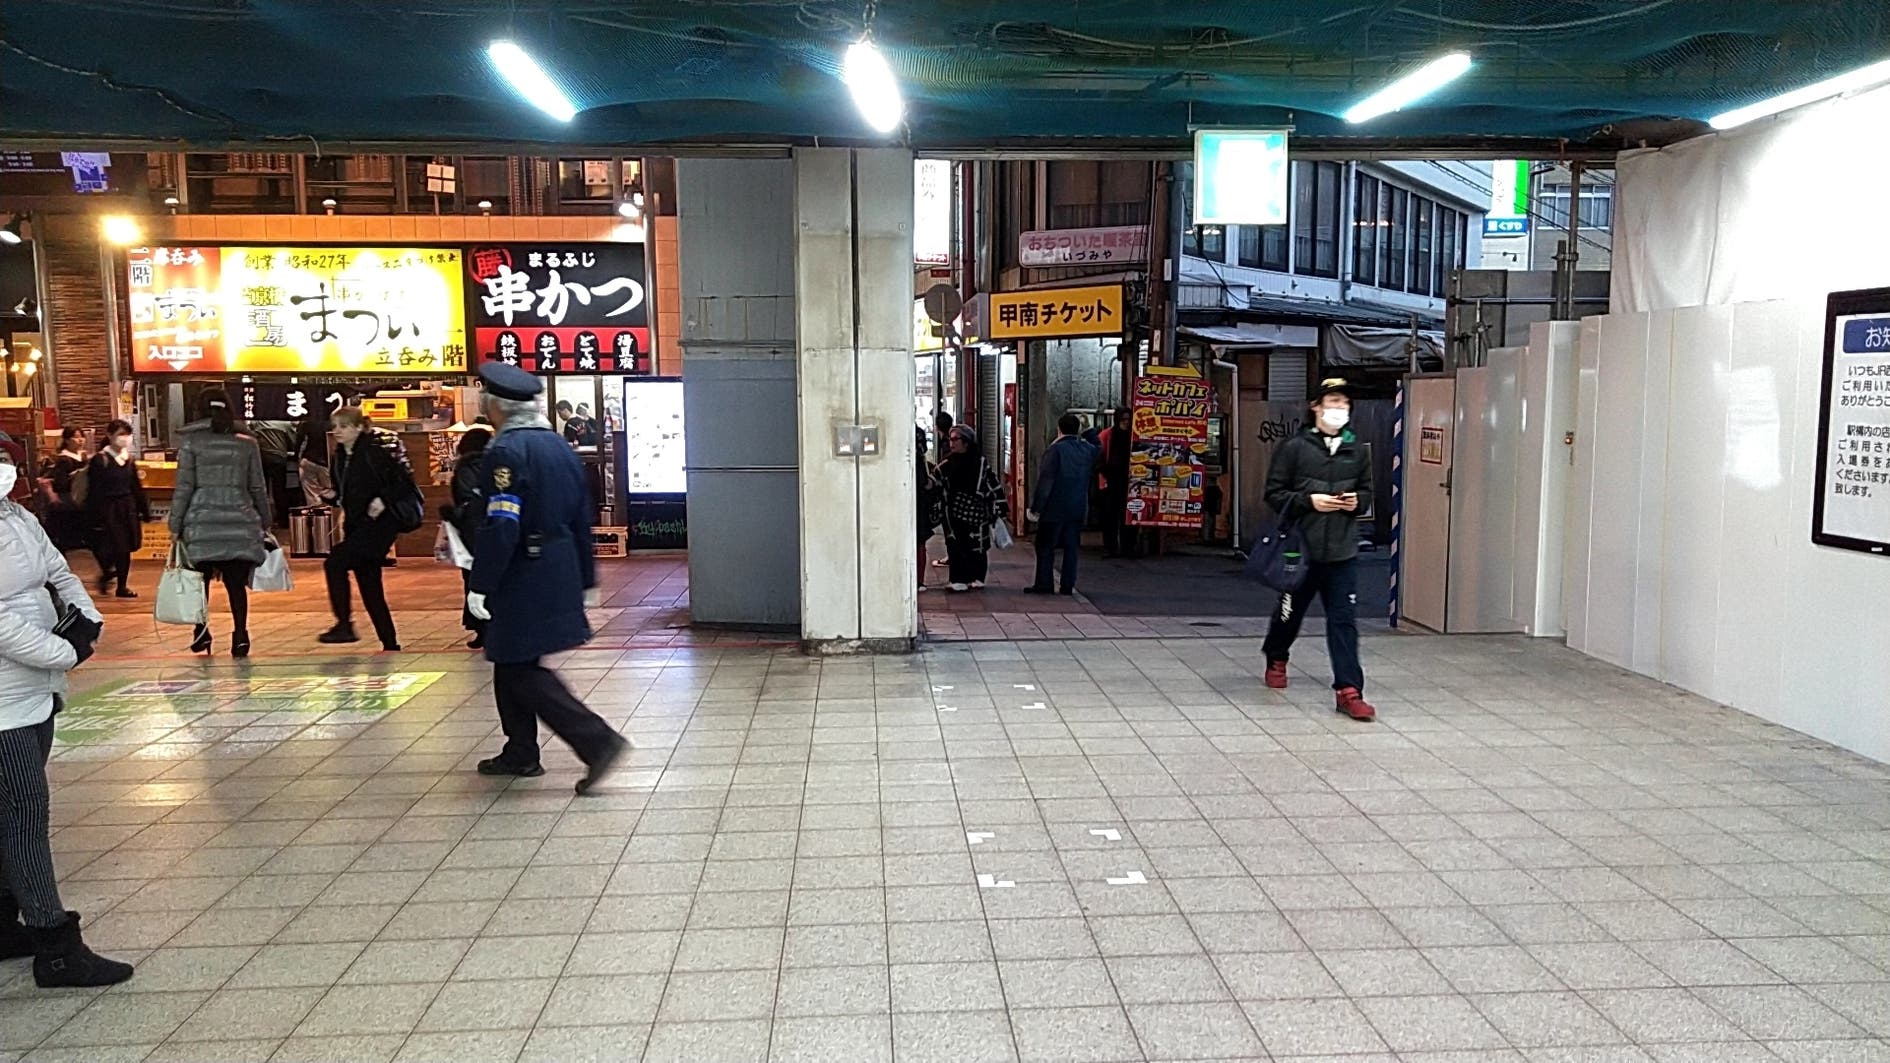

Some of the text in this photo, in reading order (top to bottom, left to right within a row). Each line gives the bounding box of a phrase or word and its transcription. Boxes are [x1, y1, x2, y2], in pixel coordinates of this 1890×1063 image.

[528, 252, 596, 269] まるふじ
[1062, 250, 1112, 262] いづみや
[481, 264, 644, 327] 串かつ
[290, 281, 421, 346] まつい
[999, 299, 1112, 329] 甲南チケット
[617, 334, 635, 370] 湯豆腐
[1138, 380, 1206, 398] ネットカフェ
[1155, 400, 1205, 417] ポパイ
